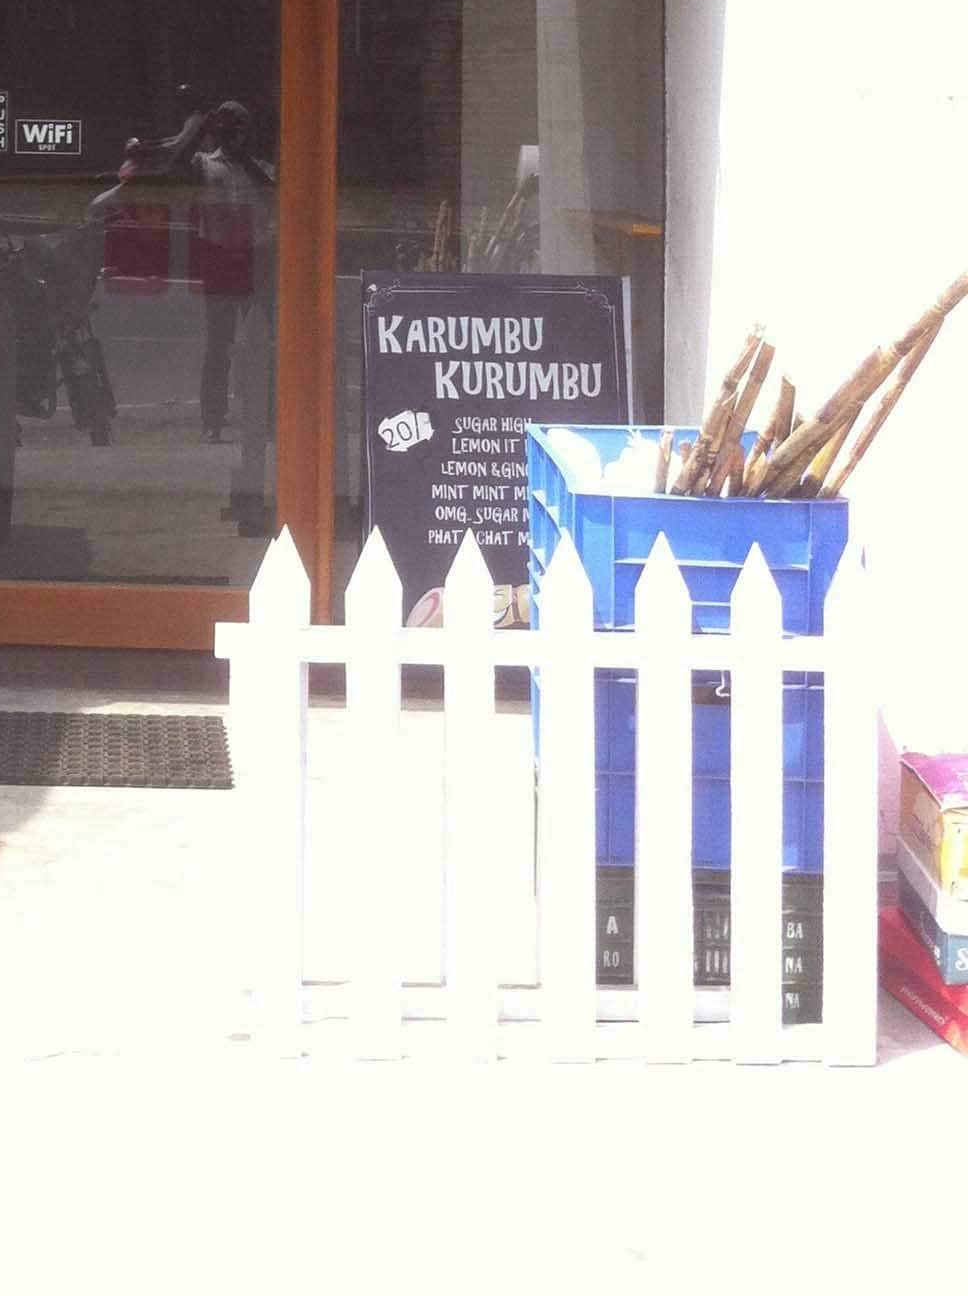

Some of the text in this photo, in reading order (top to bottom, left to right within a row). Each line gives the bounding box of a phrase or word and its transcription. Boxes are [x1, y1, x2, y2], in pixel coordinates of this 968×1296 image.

[22, 122, 73, 144] WiFi
[377, 315, 544, 354] KARUMBU
[434, 360, 602, 400] KURUMBU
[452, 416, 498, 434] SUGAR
[452, 437, 500, 454] LEMON
[504, 438, 520, 454] IT
[441, 460, 487, 476] LEMON
[431, 484, 469, 501] MINT
[472, 485, 510, 502] MINT
[428, 529, 464, 545] PHAT
[476, 530, 513, 545] CHAT
